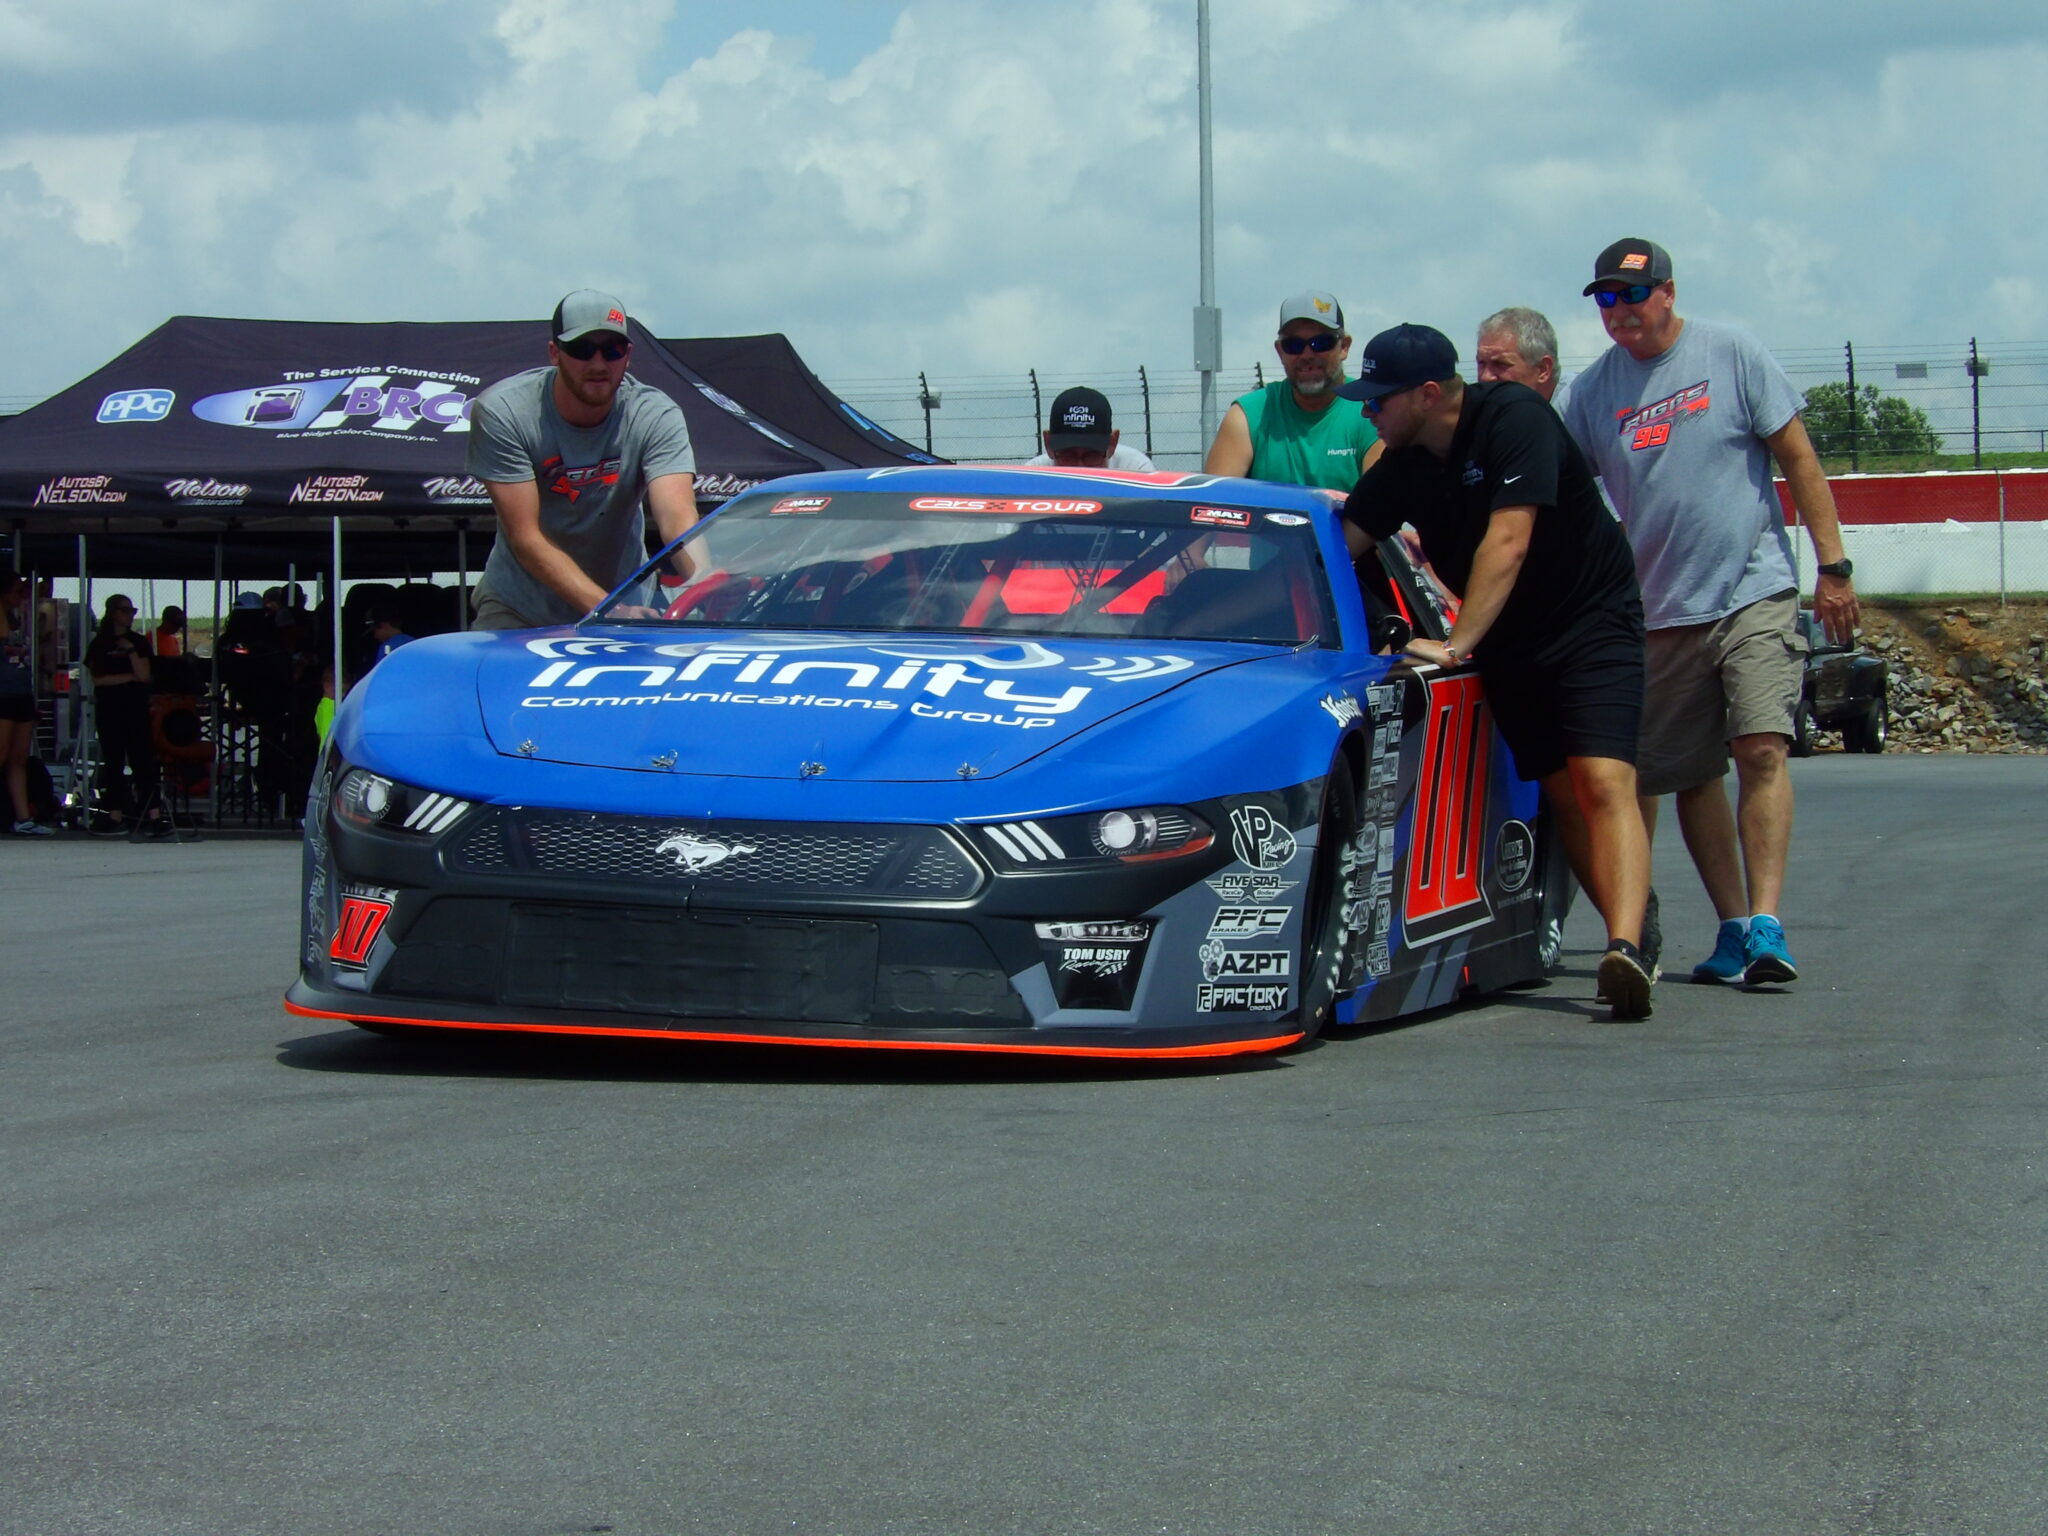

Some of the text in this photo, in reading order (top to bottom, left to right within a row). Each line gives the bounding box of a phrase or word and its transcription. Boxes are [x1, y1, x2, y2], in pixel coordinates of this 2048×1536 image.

[283, 365, 480, 385] The Service Connection
[103, 393, 169, 419] PPG
[301, 430, 332, 438] Ridge
[1631, 422, 1671, 451] 99
[165, 478, 251, 498] Nelson
[422, 475, 489, 498] Nelso
[1013, 501, 1096, 512] TOUR
[1229, 805, 1274, 870] VP
[1262, 838, 1294, 860] Racing
[1222, 876, 1279, 888] FIVE STAR
[1213, 909, 1289, 926] PFC
[1063, 948, 1131, 960] TOM USRY
[1219, 953, 1288, 974] AZPT
[1059, 959, 1111, 974] Racing
[1213, 984, 1289, 1009] FACTORY
